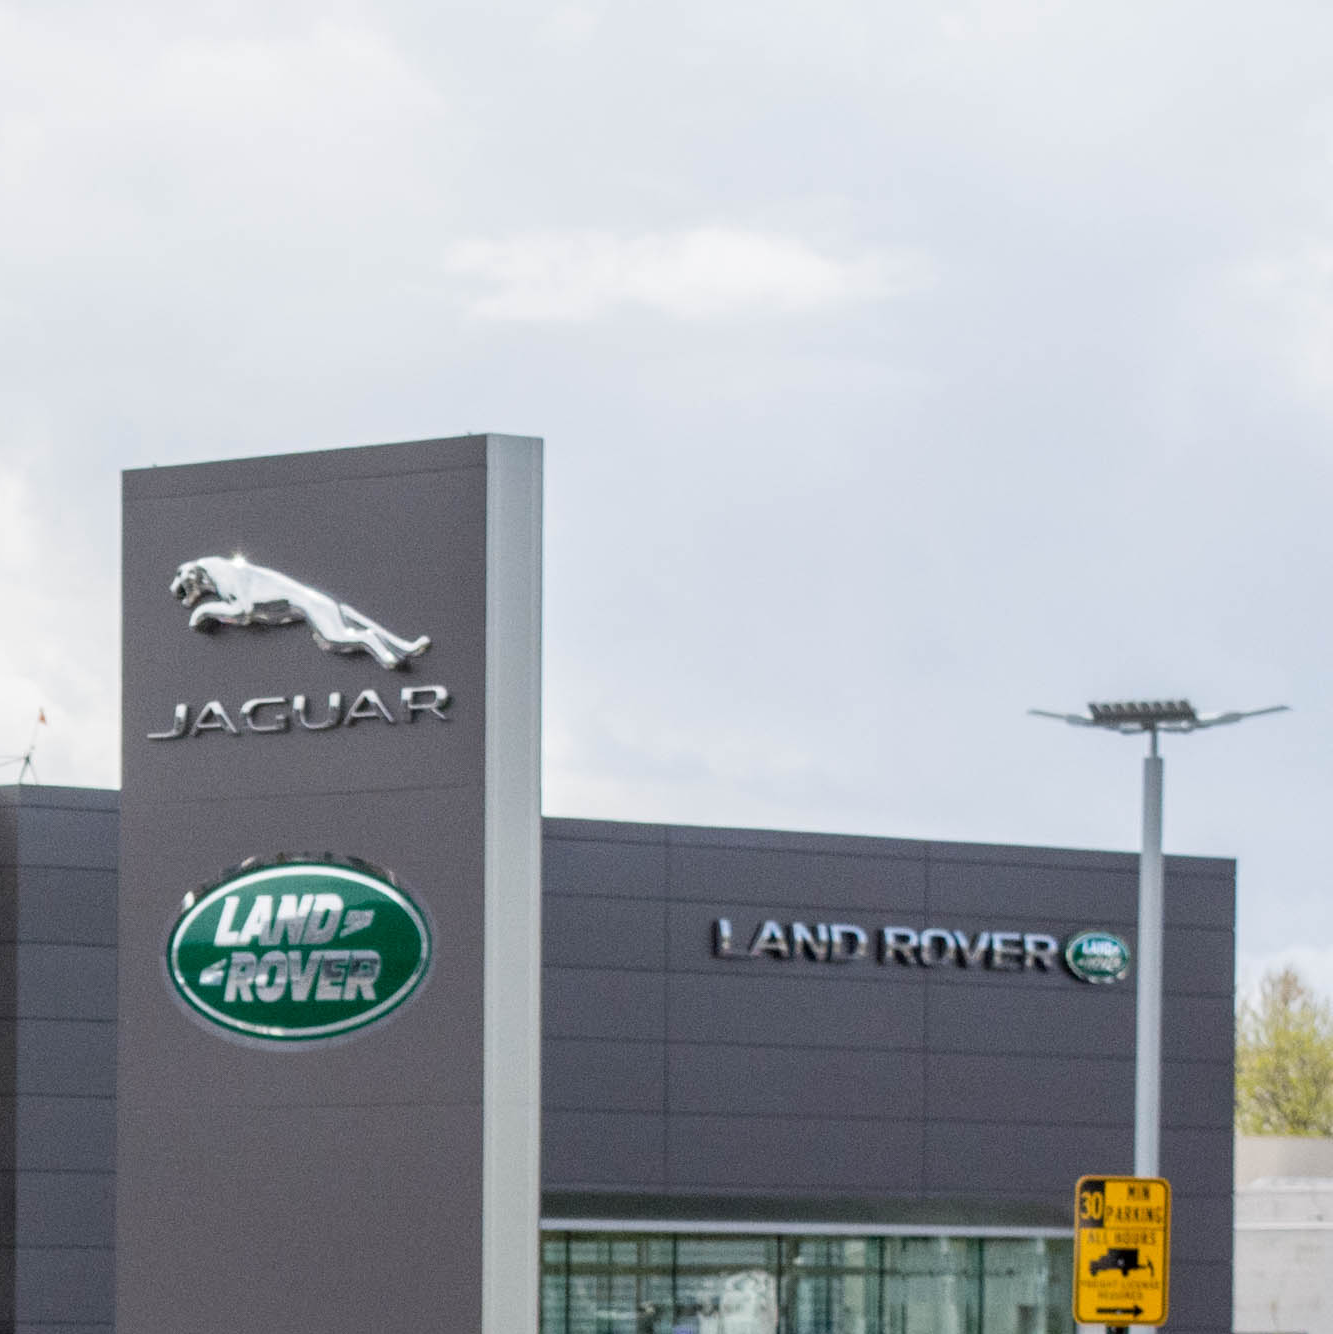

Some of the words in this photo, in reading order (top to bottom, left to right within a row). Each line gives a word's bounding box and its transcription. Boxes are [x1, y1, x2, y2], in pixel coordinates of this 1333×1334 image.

[147, 685, 448, 738] JAGUAR
[213, 893, 344, 947] LAND
[716, 918, 869, 962] LAND
[883, 926, 1059, 970] ROVER
[223, 950, 382, 1003] ROVER
[1080, 1190, 1103, 1220] 30
[1126, 1183, 1151, 1200] MIN
[1105, 1205, 1164, 1223] PARKING
[1087, 1231, 1109, 1245] ALL
[1113, 1231, 1157, 1246] HOURS
